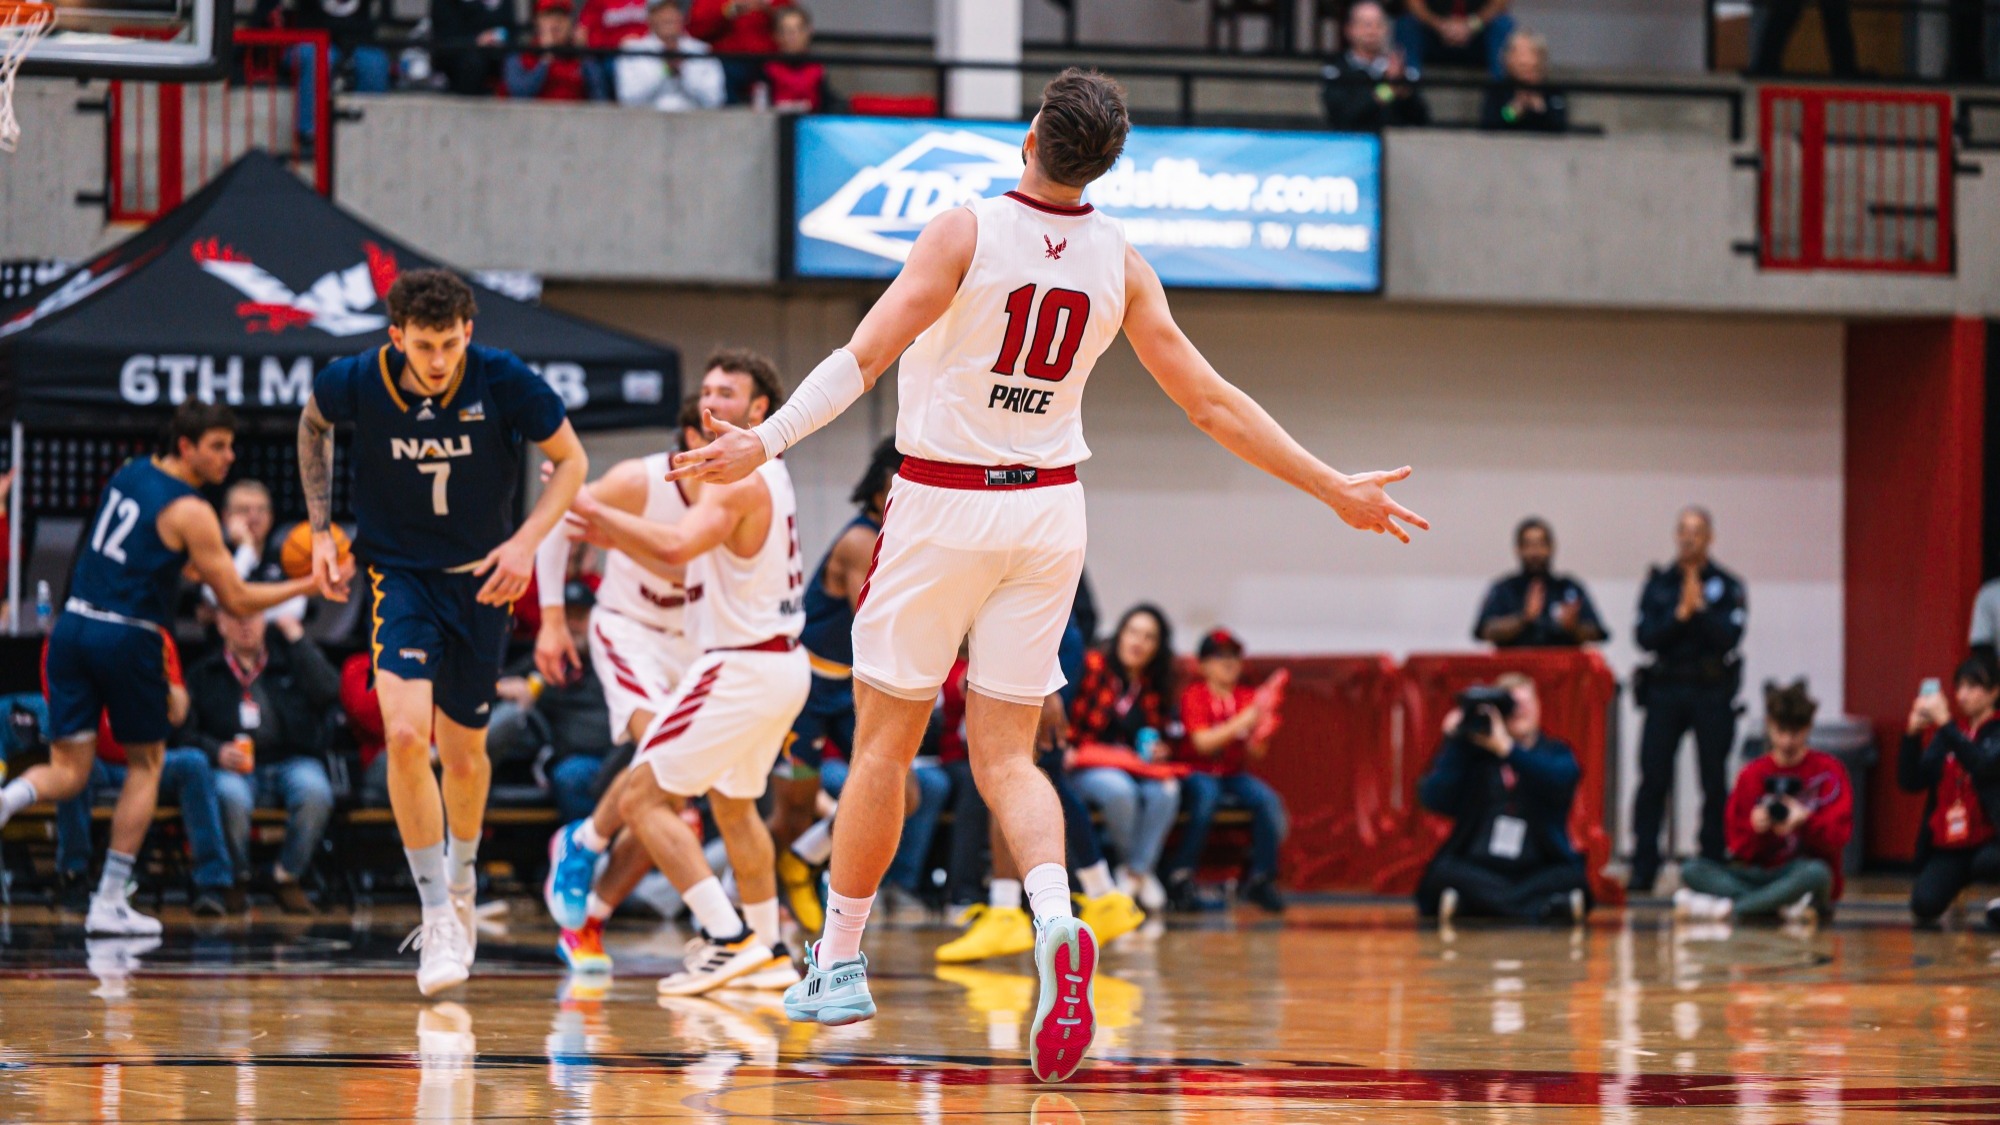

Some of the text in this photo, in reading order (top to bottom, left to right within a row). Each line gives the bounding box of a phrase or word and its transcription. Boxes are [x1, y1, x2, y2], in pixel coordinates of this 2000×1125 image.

[990, 282, 1091, 382] 10
[119, 353, 245, 406] 6TH
[988, 384, 1054, 415] PRICE
[389, 434, 473, 460] NAU
[416, 461, 451, 516] 7
[91, 486, 140, 565] 12
